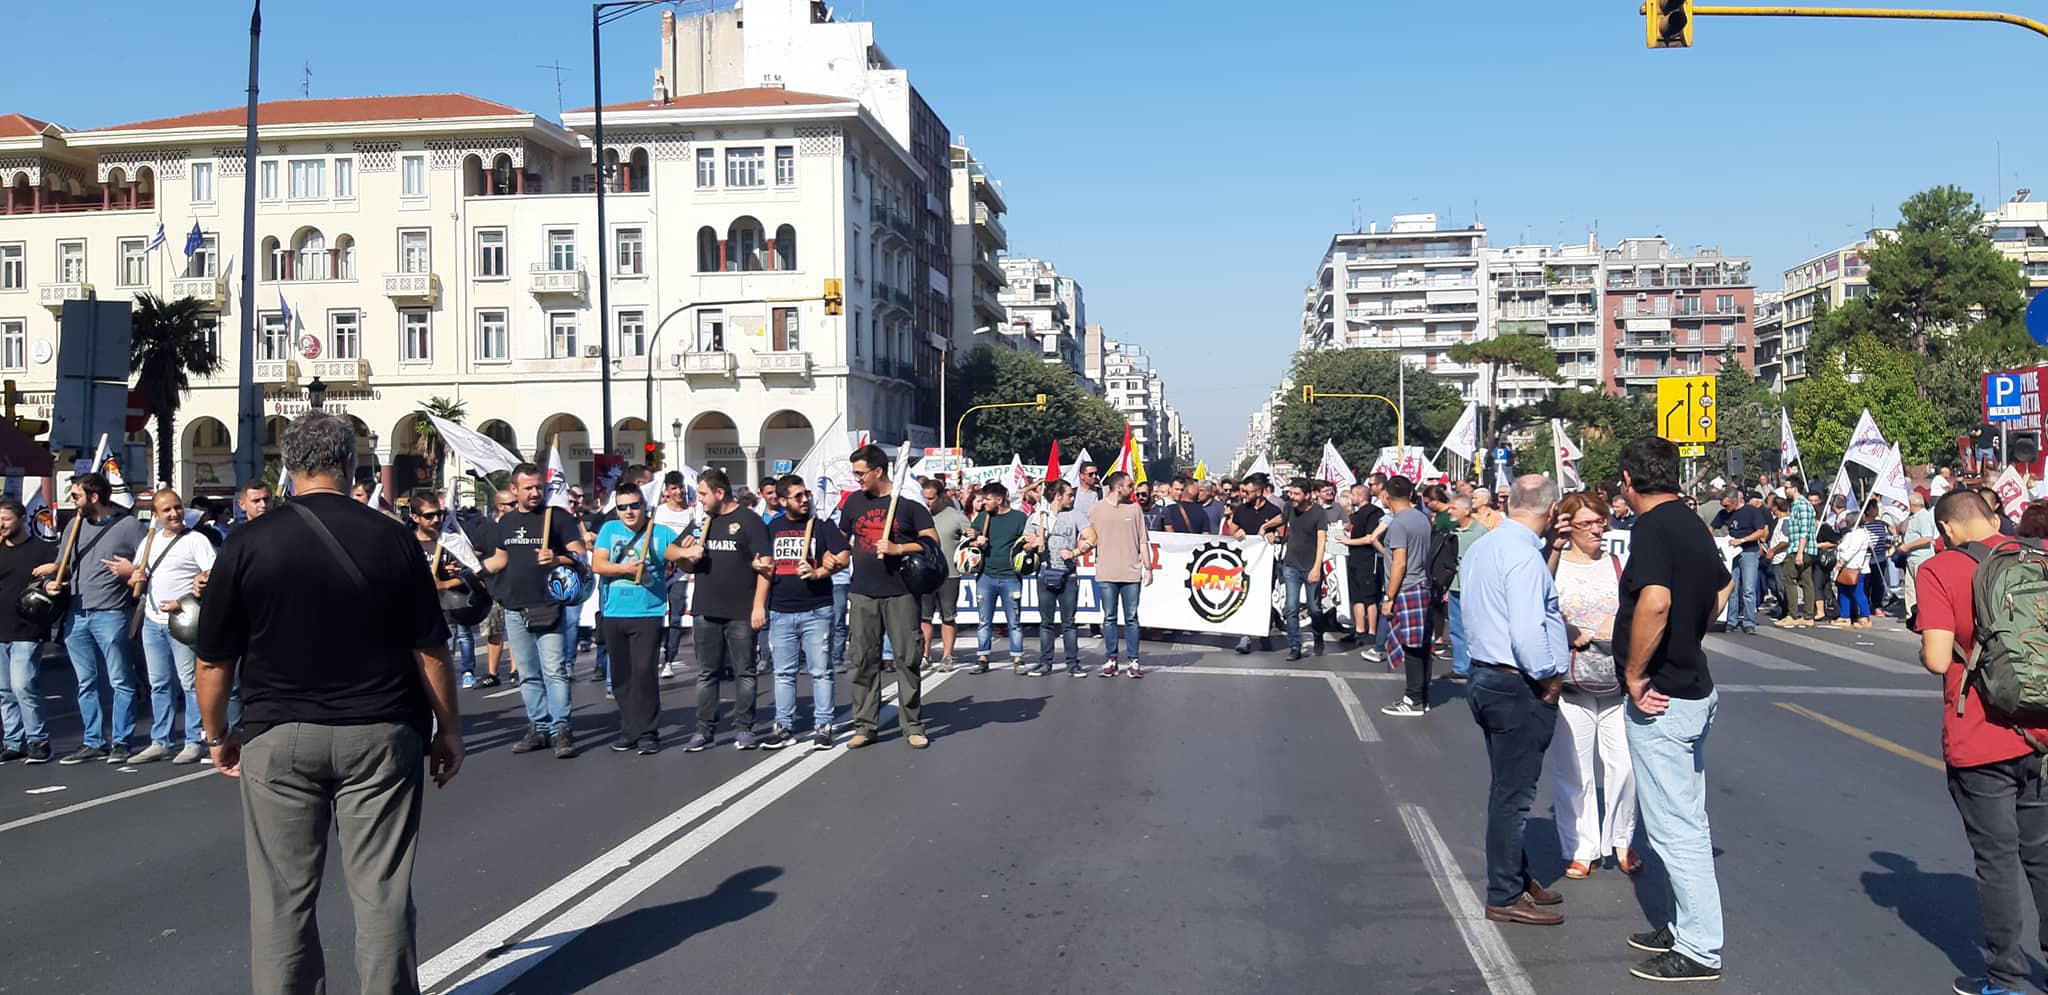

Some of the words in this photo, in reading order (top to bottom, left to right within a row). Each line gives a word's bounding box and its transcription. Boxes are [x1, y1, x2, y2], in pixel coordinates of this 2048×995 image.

[1996, 377, 2014, 406] P
[776, 539, 797, 547] ART
[776, 548, 803, 557] DENI
